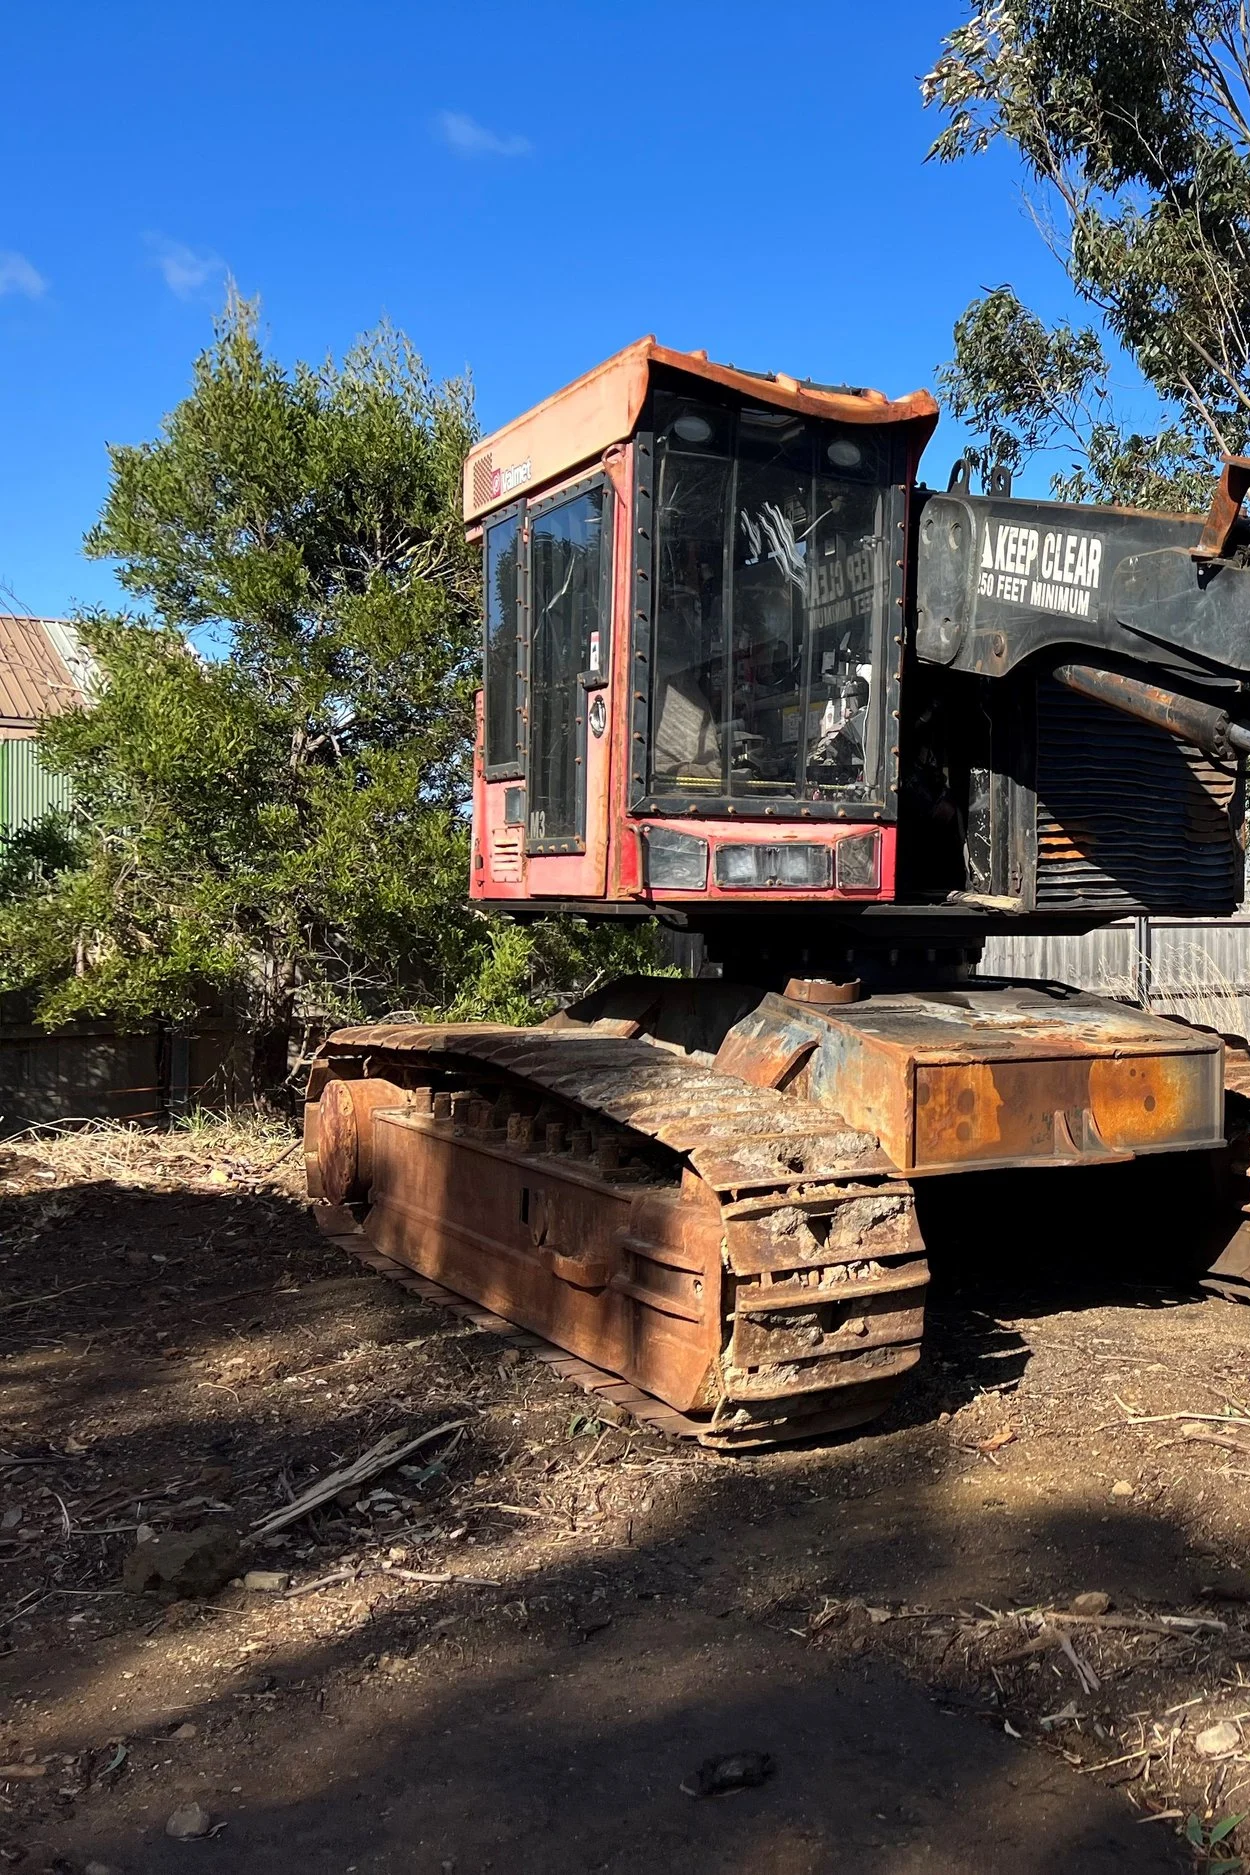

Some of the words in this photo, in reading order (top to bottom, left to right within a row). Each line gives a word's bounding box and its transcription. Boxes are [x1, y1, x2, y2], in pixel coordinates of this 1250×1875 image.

[994, 524, 1039, 576] KEEP
[1042, 532, 1102, 589] CLEAR
[996, 575, 1027, 603] FEET
[1030, 582, 1091, 617] MINIMUM
